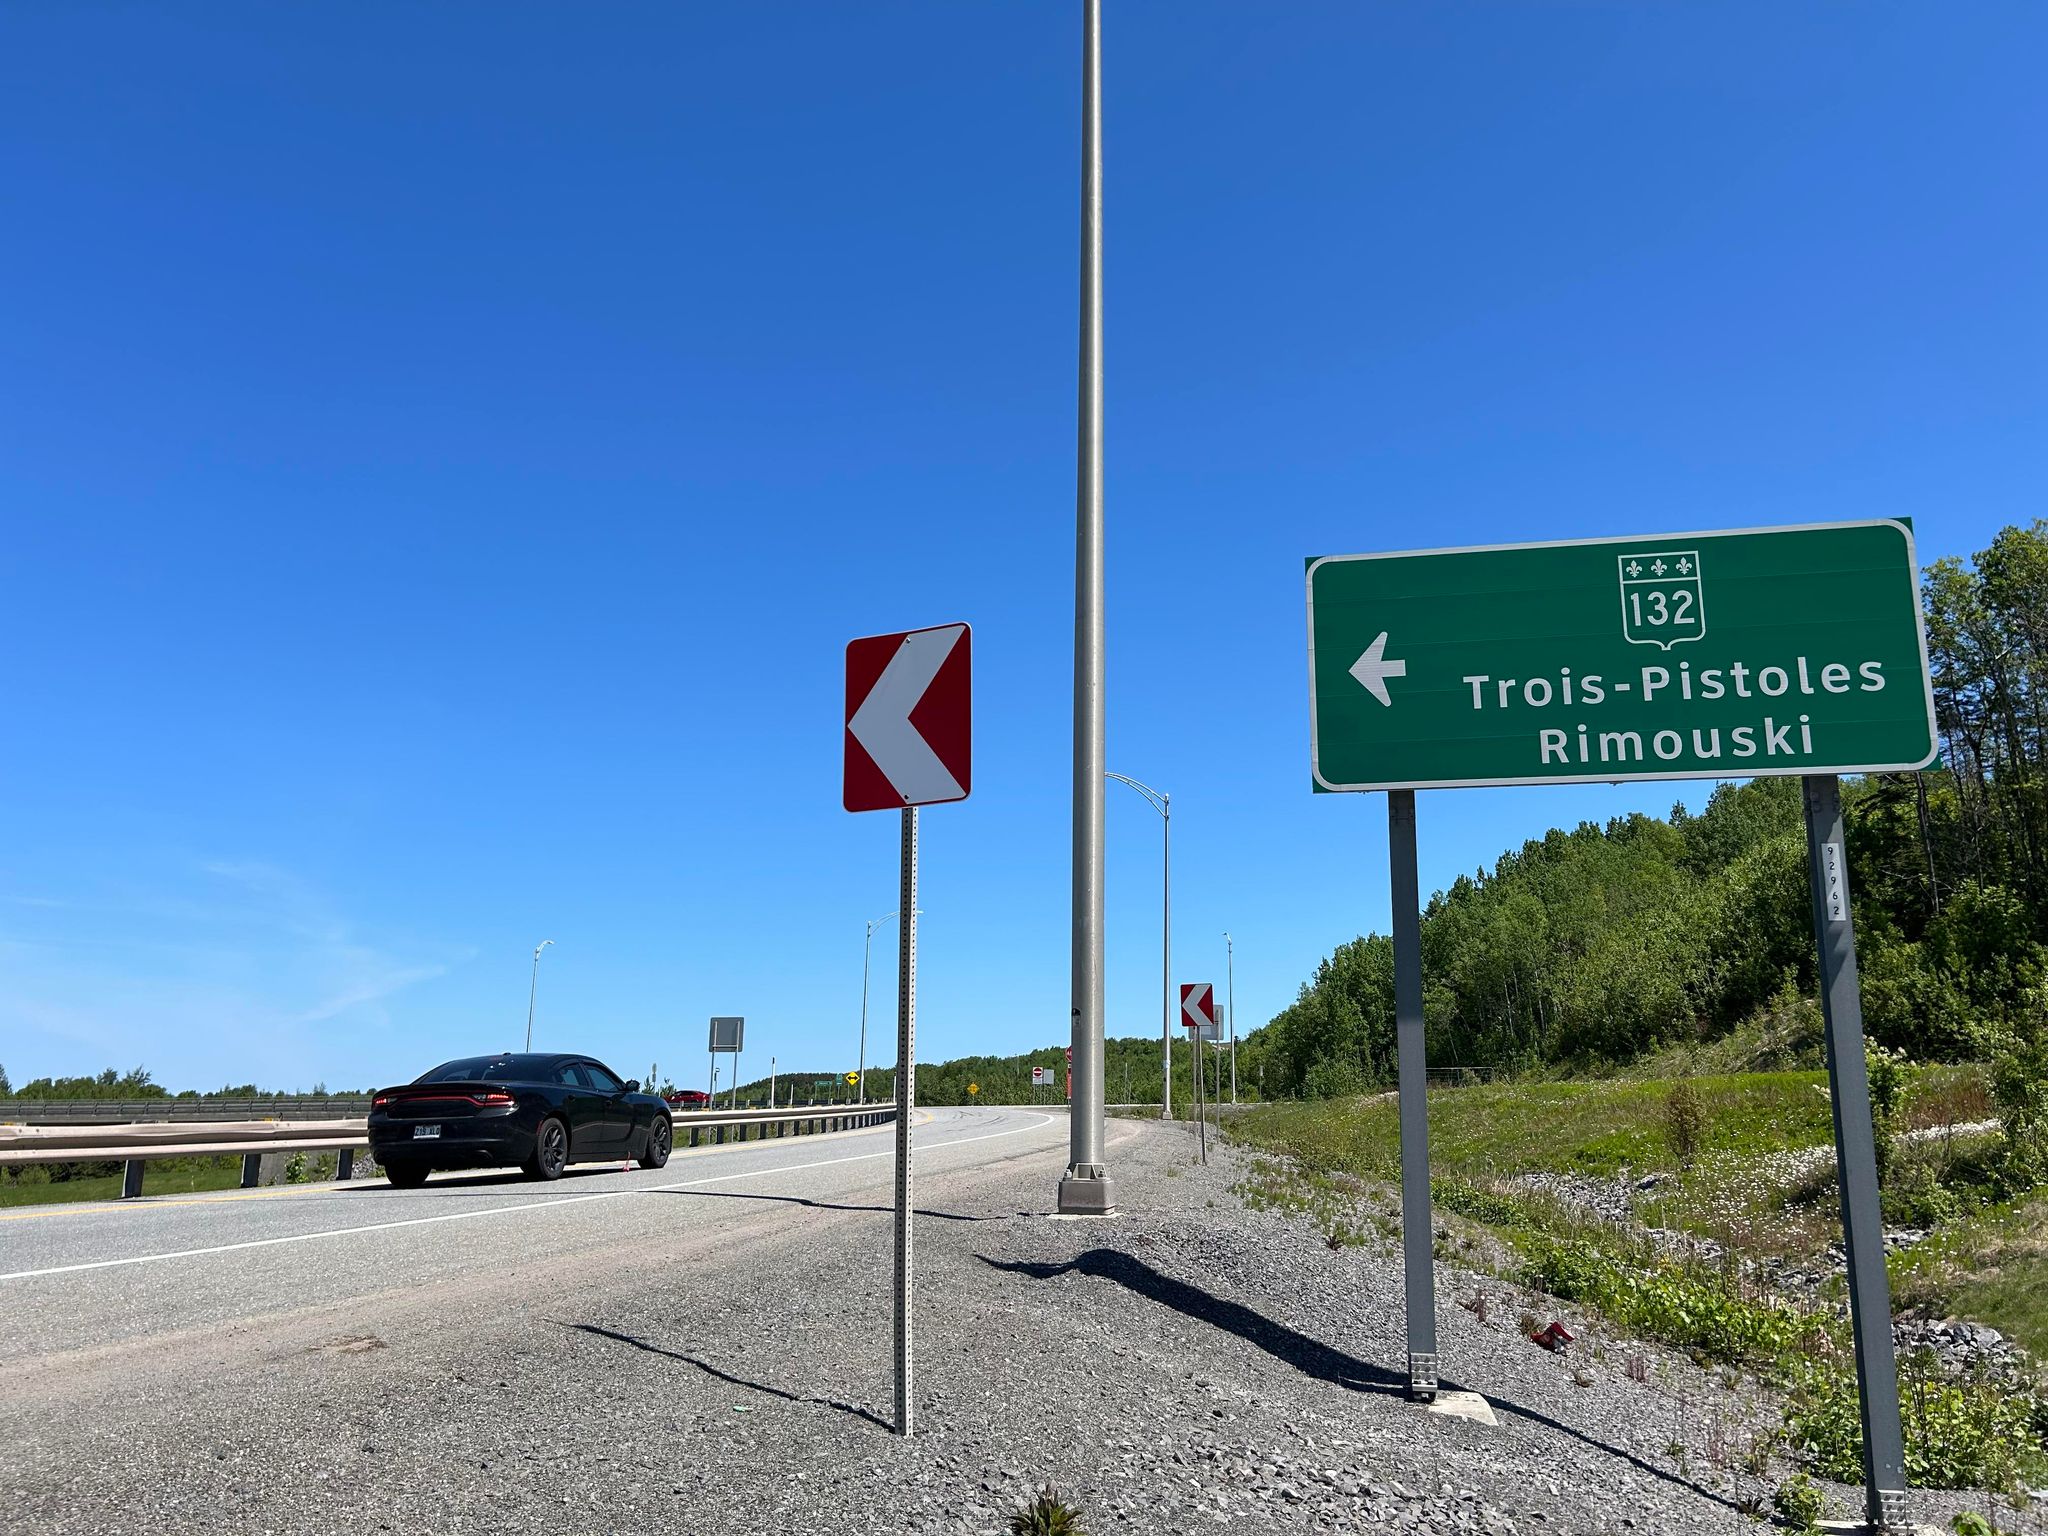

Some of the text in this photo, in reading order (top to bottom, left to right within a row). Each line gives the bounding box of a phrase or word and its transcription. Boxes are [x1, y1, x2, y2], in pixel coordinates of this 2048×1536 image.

[1631, 589, 1695, 627] 132
[1463, 656, 1886, 710] Trois-Pistoles
[1540, 714, 1813, 764] Rimouski
[1827, 846, 1840, 915] 92962
